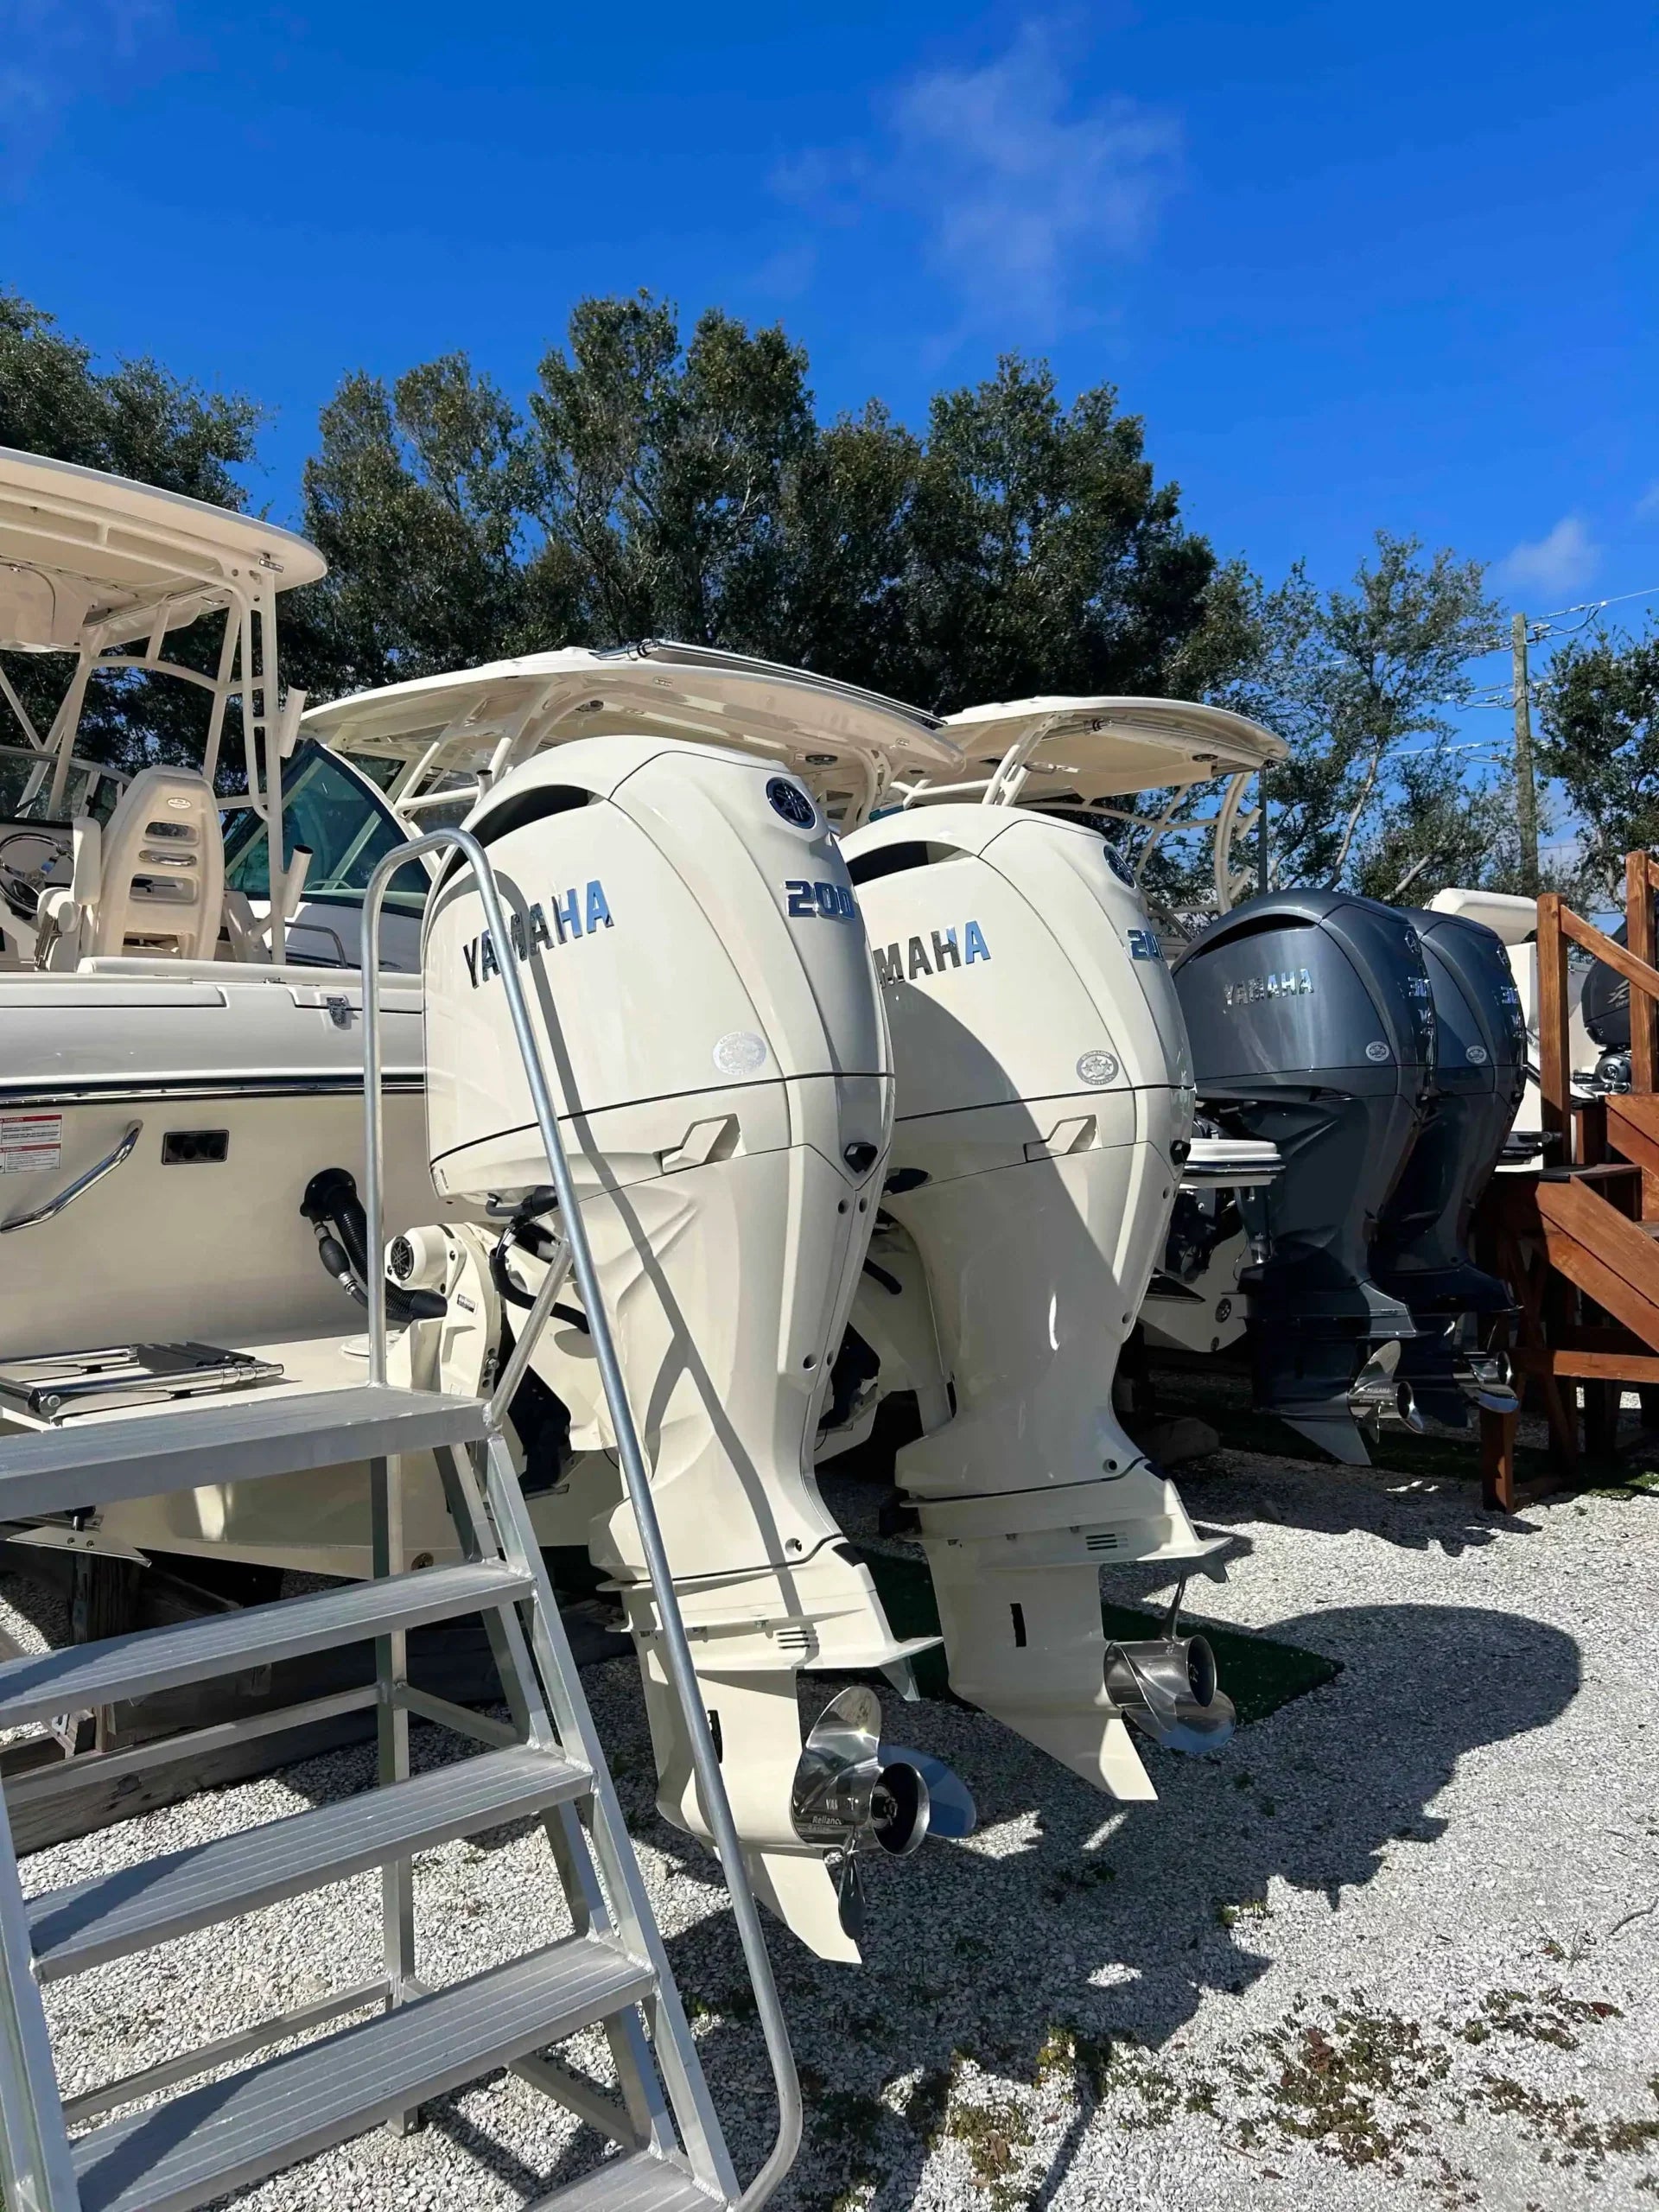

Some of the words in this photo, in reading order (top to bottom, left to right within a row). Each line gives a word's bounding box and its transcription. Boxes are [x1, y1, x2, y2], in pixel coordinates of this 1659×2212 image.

[784, 880, 857, 923] 200
[872, 920, 991, 988] MAHA
[1224, 968, 1314, 1005] YAMAHA
